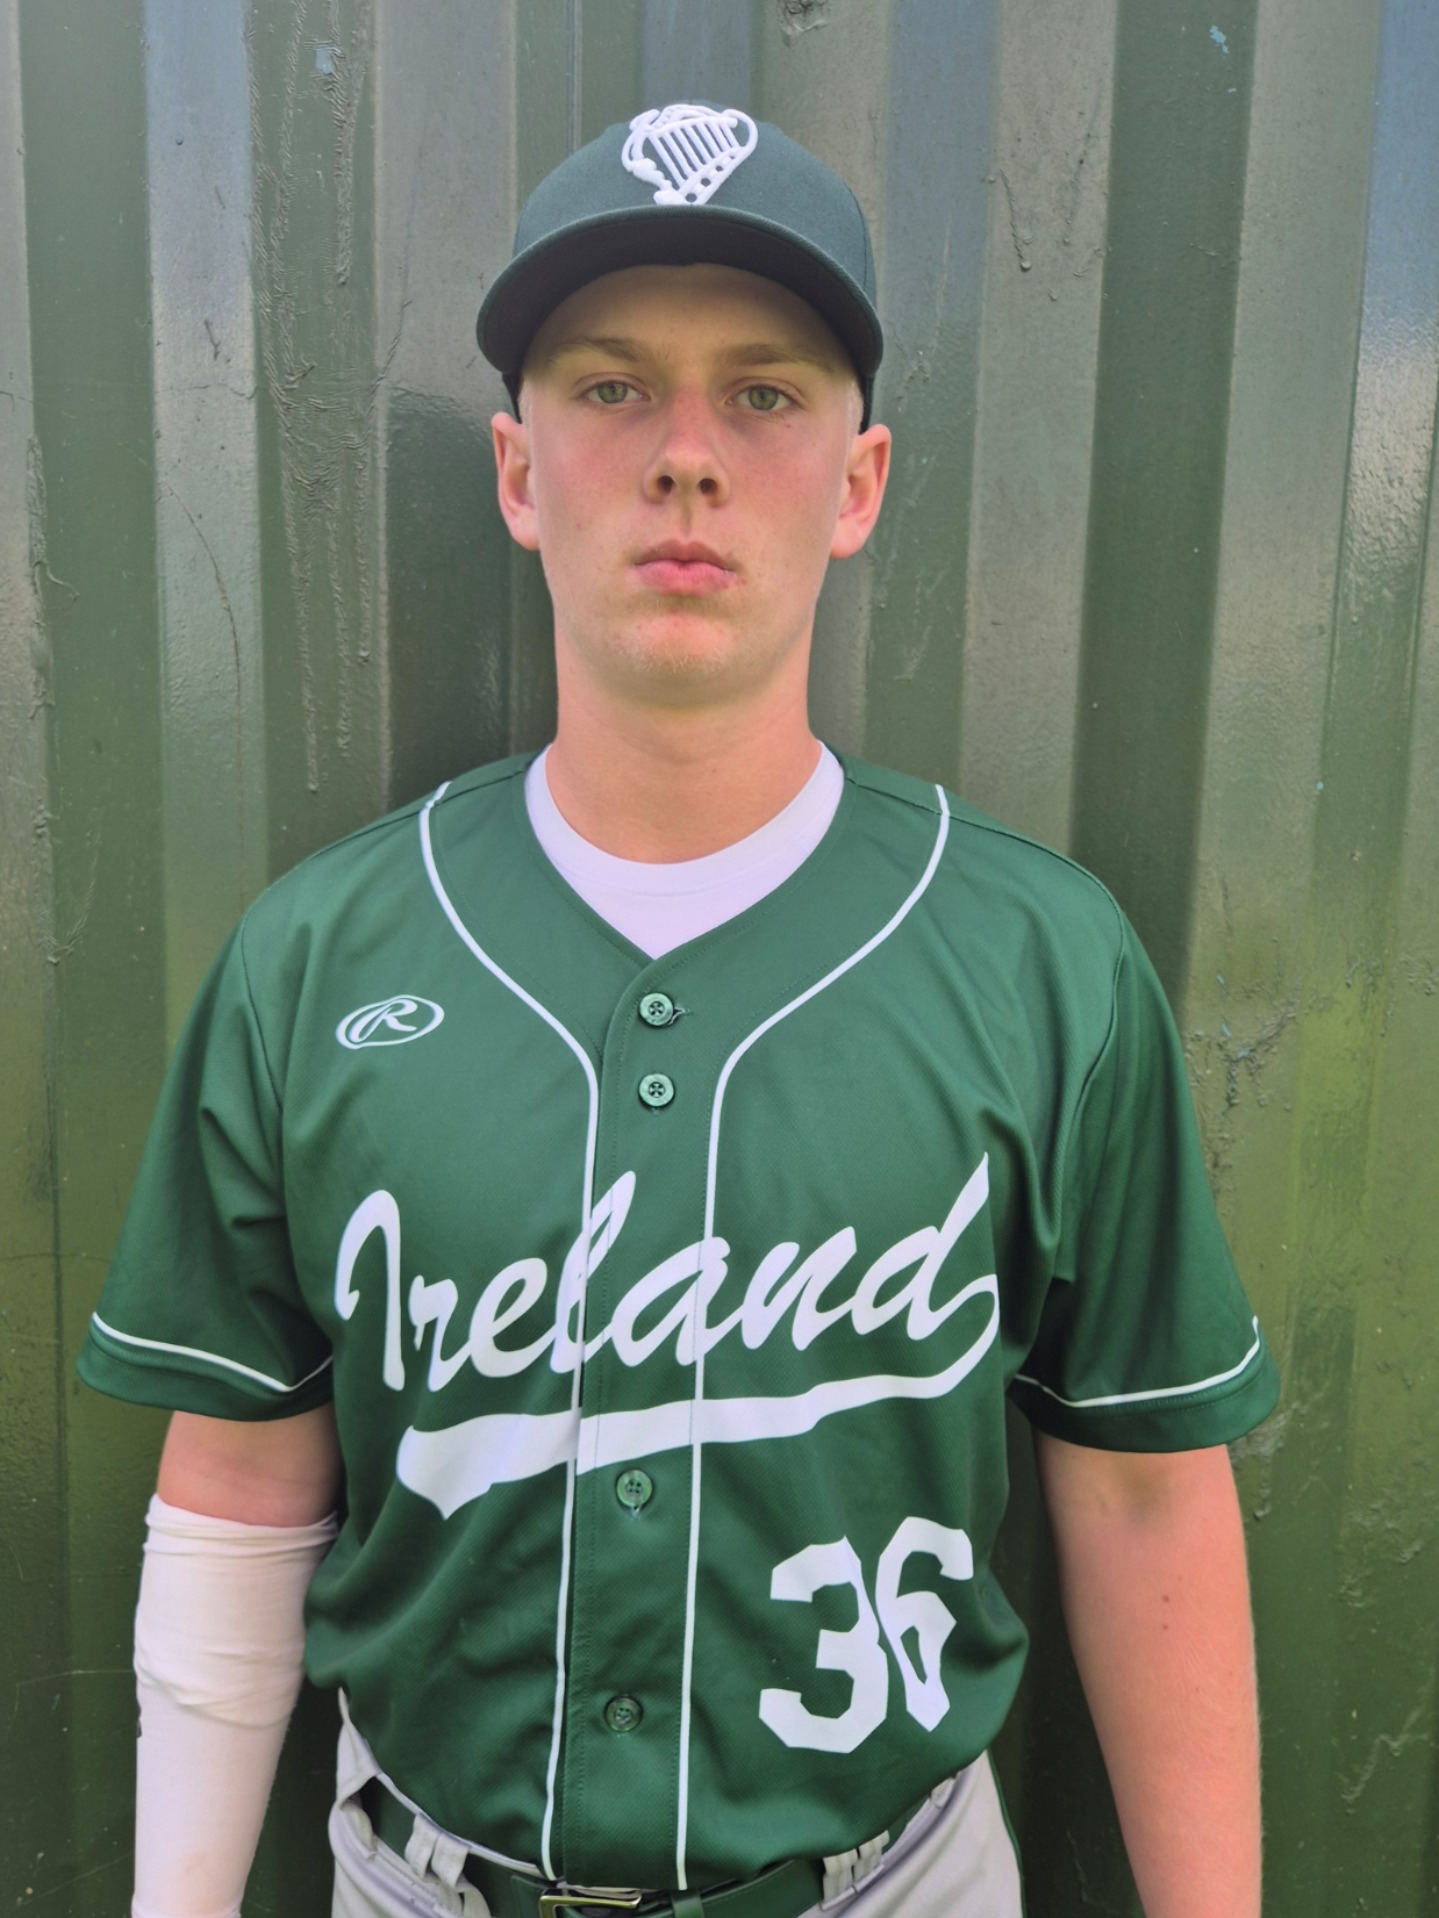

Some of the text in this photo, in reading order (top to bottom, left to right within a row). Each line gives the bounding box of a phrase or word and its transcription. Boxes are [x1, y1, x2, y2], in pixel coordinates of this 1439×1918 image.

[350, 998, 418, 1043] R
[335, 1152, 1000, 1392] Ireland
[758, 1515, 974, 1754] 36
